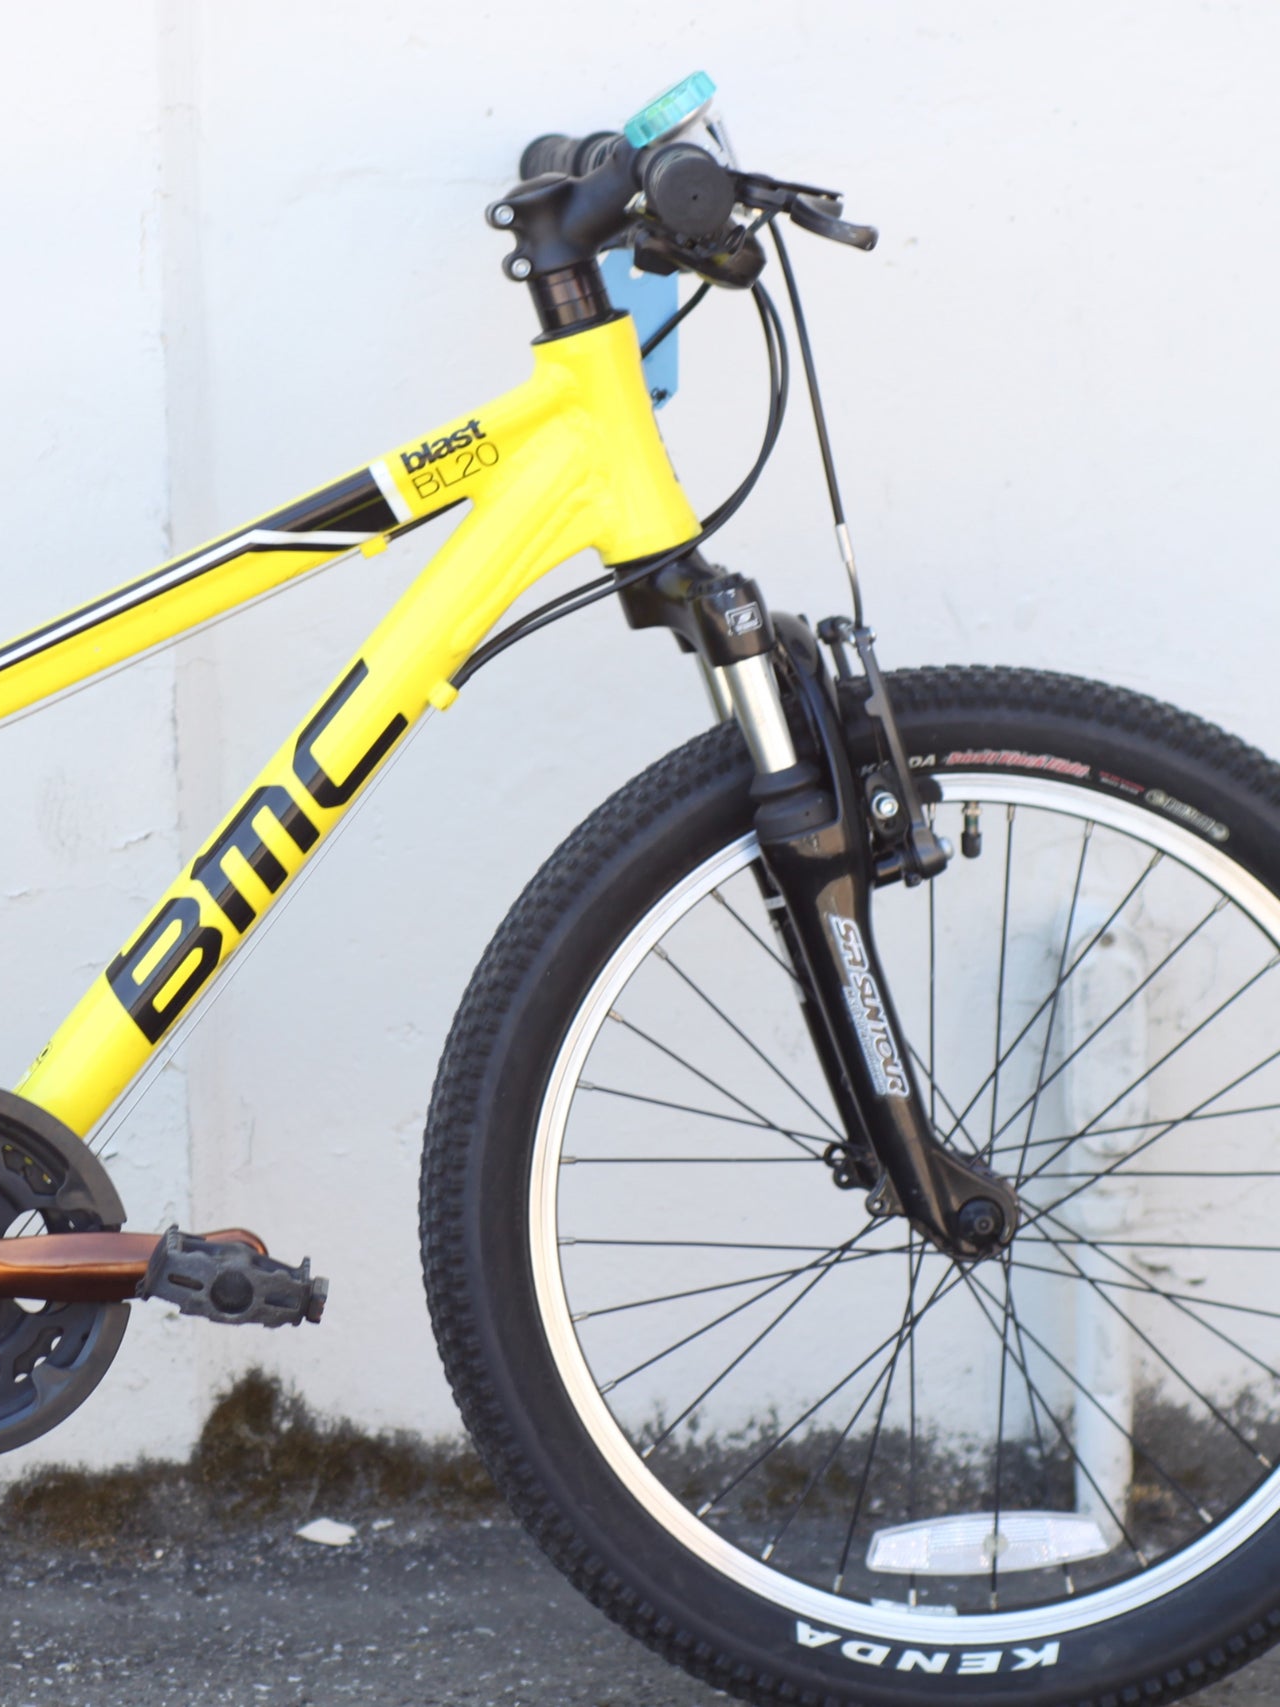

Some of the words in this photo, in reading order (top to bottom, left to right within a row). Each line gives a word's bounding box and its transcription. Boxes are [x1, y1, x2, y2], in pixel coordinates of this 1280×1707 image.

[400, 418, 486, 474] blast
[411, 441, 499, 499] BL20
[105, 657, 409, 1046] BMC
[796, 1620, 1061, 1674] KENDA
